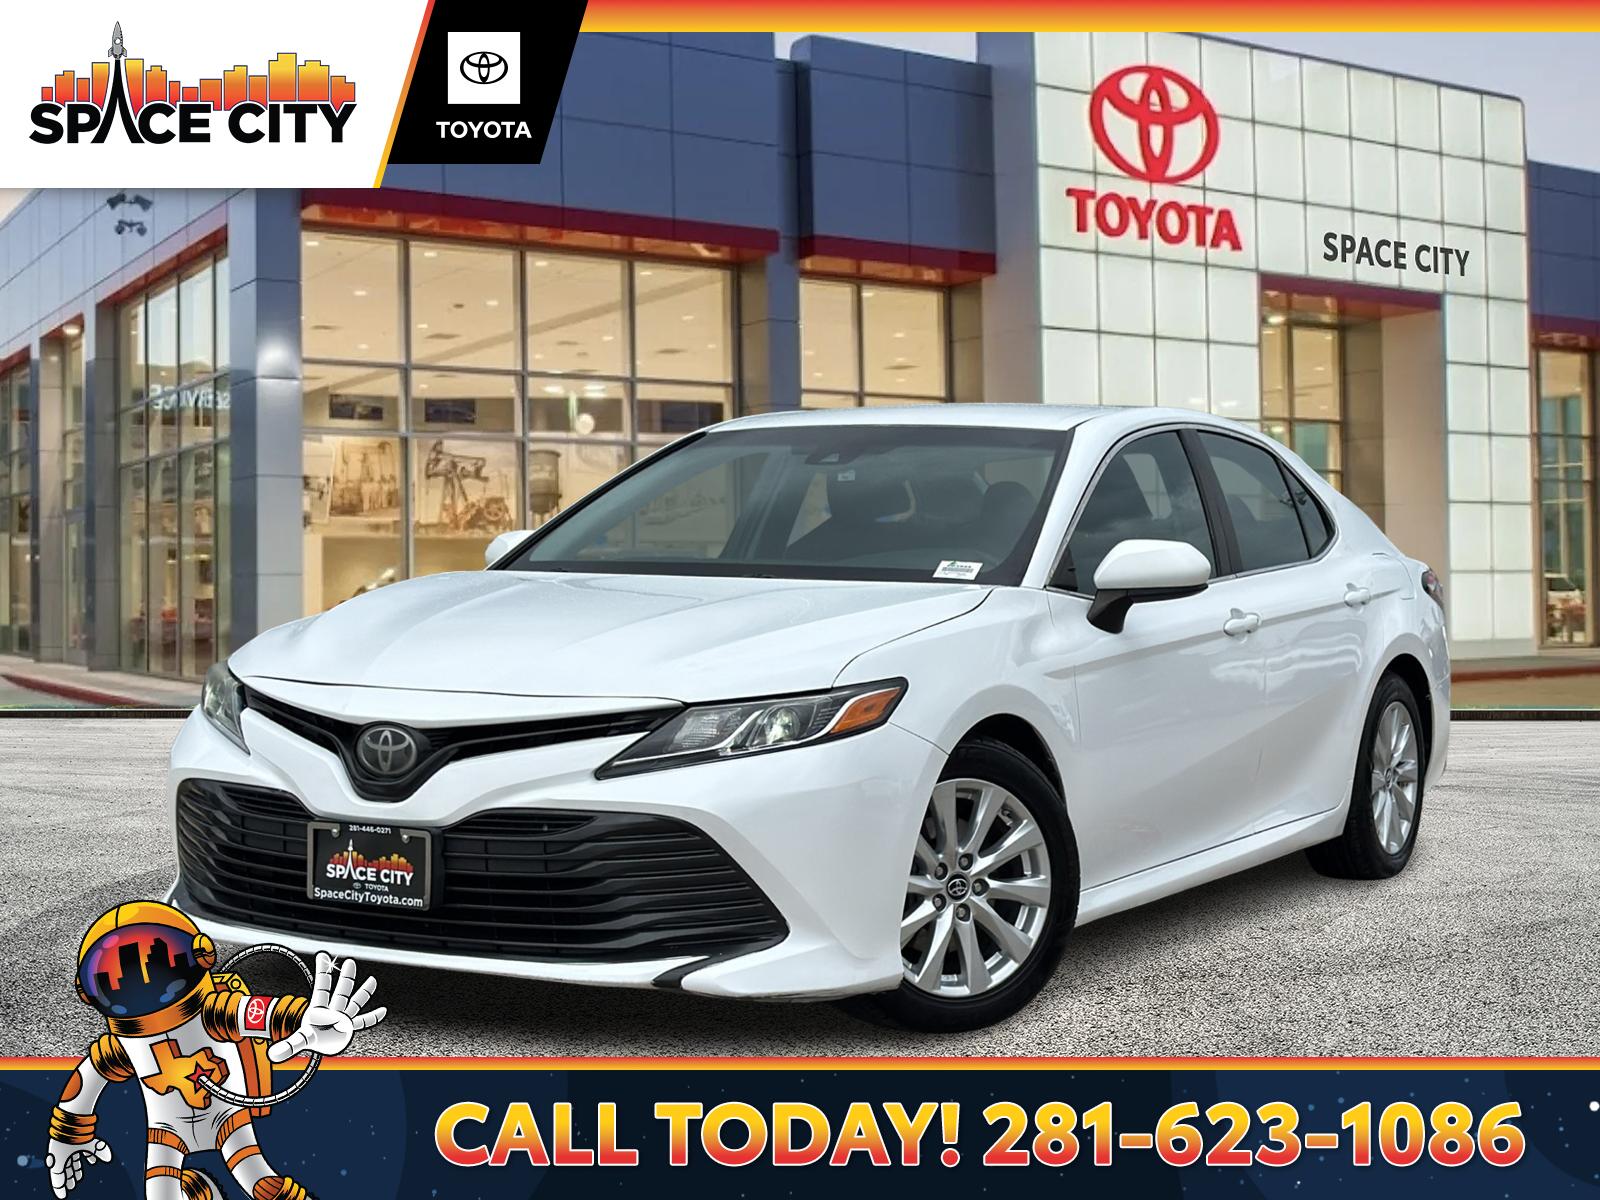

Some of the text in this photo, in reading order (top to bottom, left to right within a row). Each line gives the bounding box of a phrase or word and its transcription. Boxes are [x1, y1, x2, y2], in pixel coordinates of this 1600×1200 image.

[1066, 187, 1243, 251] TOYOTA
[1323, 232, 1470, 277] SPACE CITY
[326, 863, 414, 886] SPACE CITY
[314, 887, 423, 907] SpaceCityToyota.com
[365, 883, 389, 892] TOYOTA
